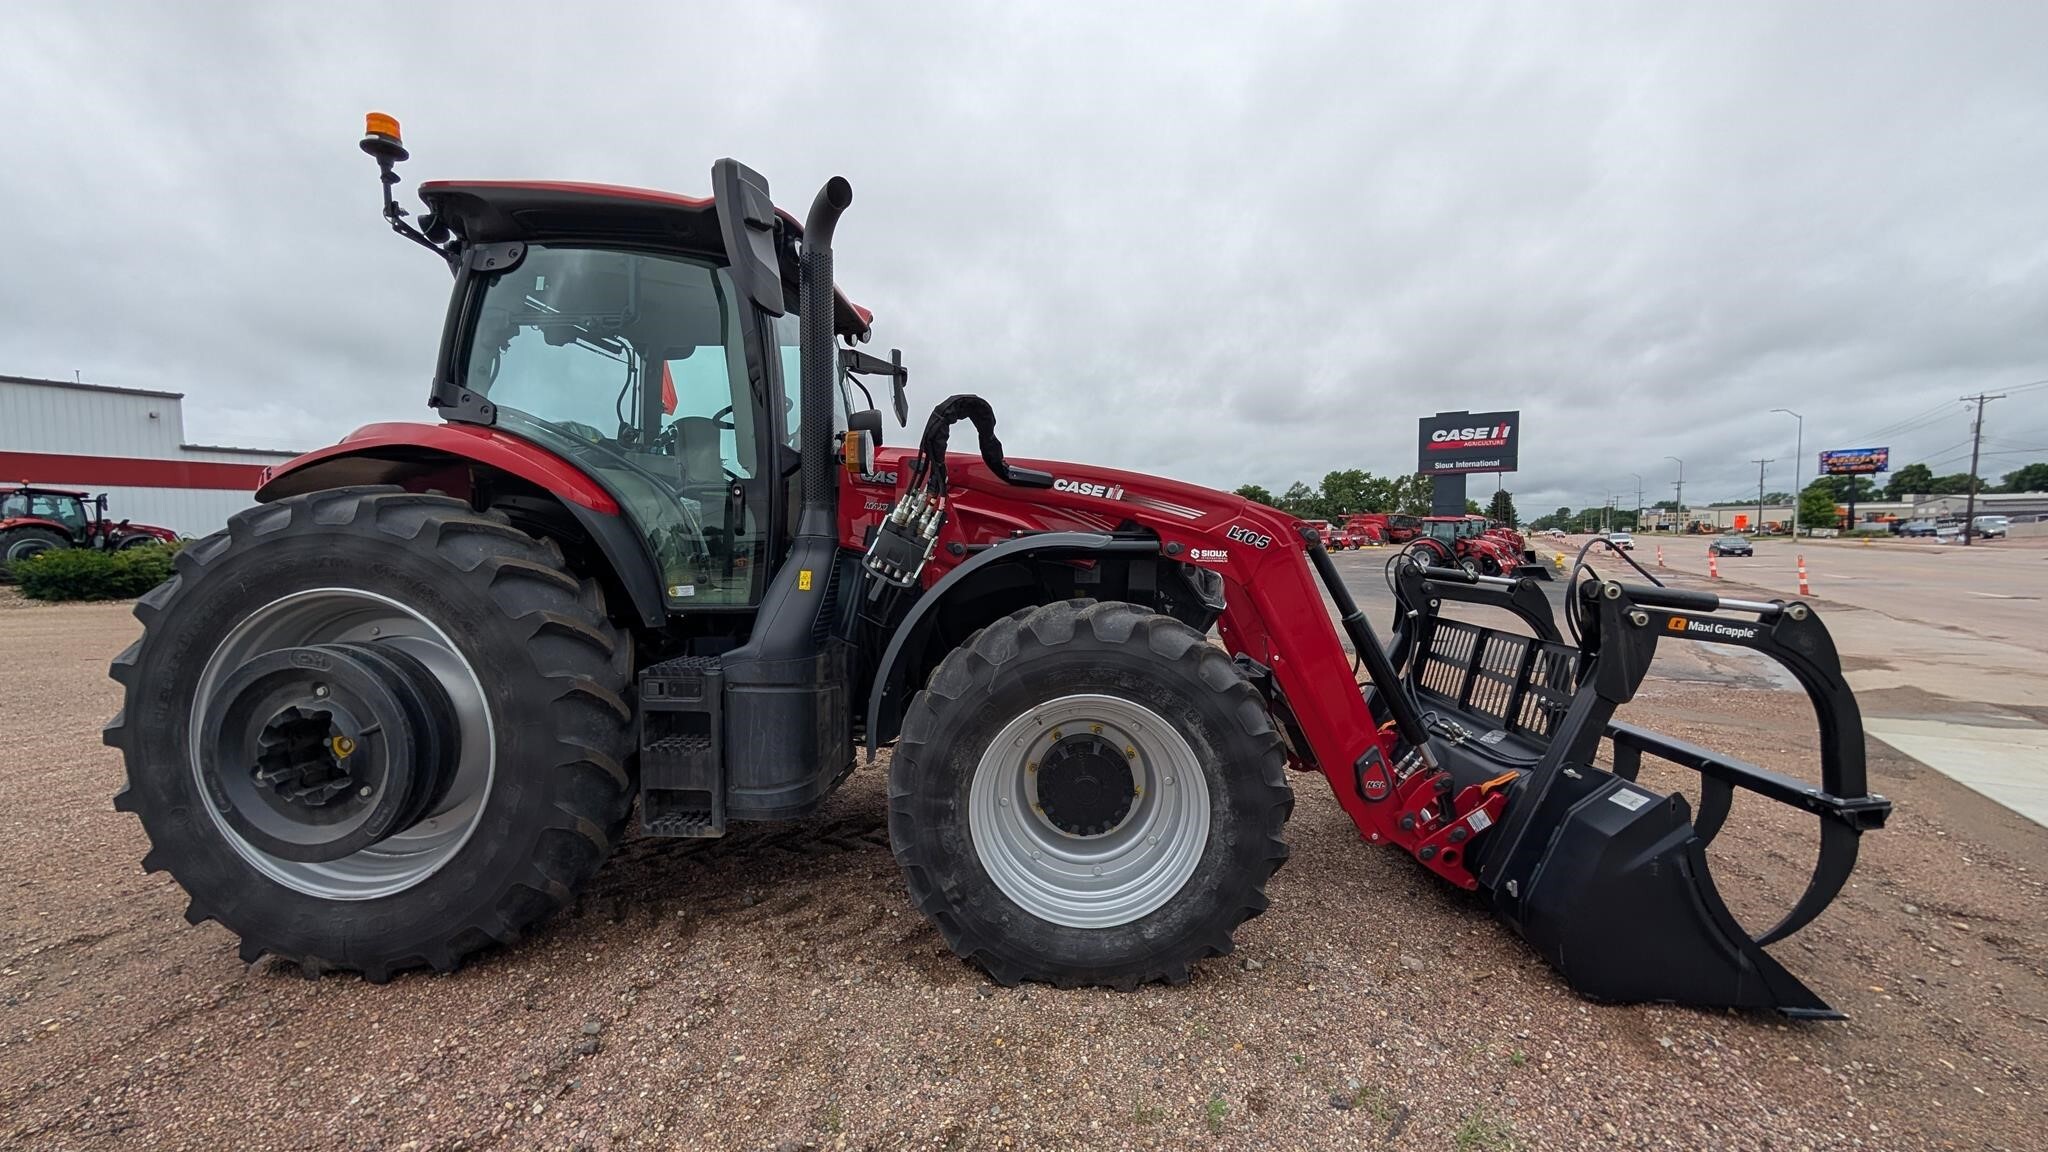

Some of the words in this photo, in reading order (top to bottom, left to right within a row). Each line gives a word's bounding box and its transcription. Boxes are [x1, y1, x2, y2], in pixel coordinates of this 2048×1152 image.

[1432, 427, 1490, 442] CASE
[1455, 459, 1500, 468] International
[861, 471, 898, 483] CAS
[1053, 479, 1106, 498] CASE
[1226, 525, 1272, 549] L105
[1201, 550, 1228, 558] SIOUX
[1688, 621, 1714, 633] Maxi
